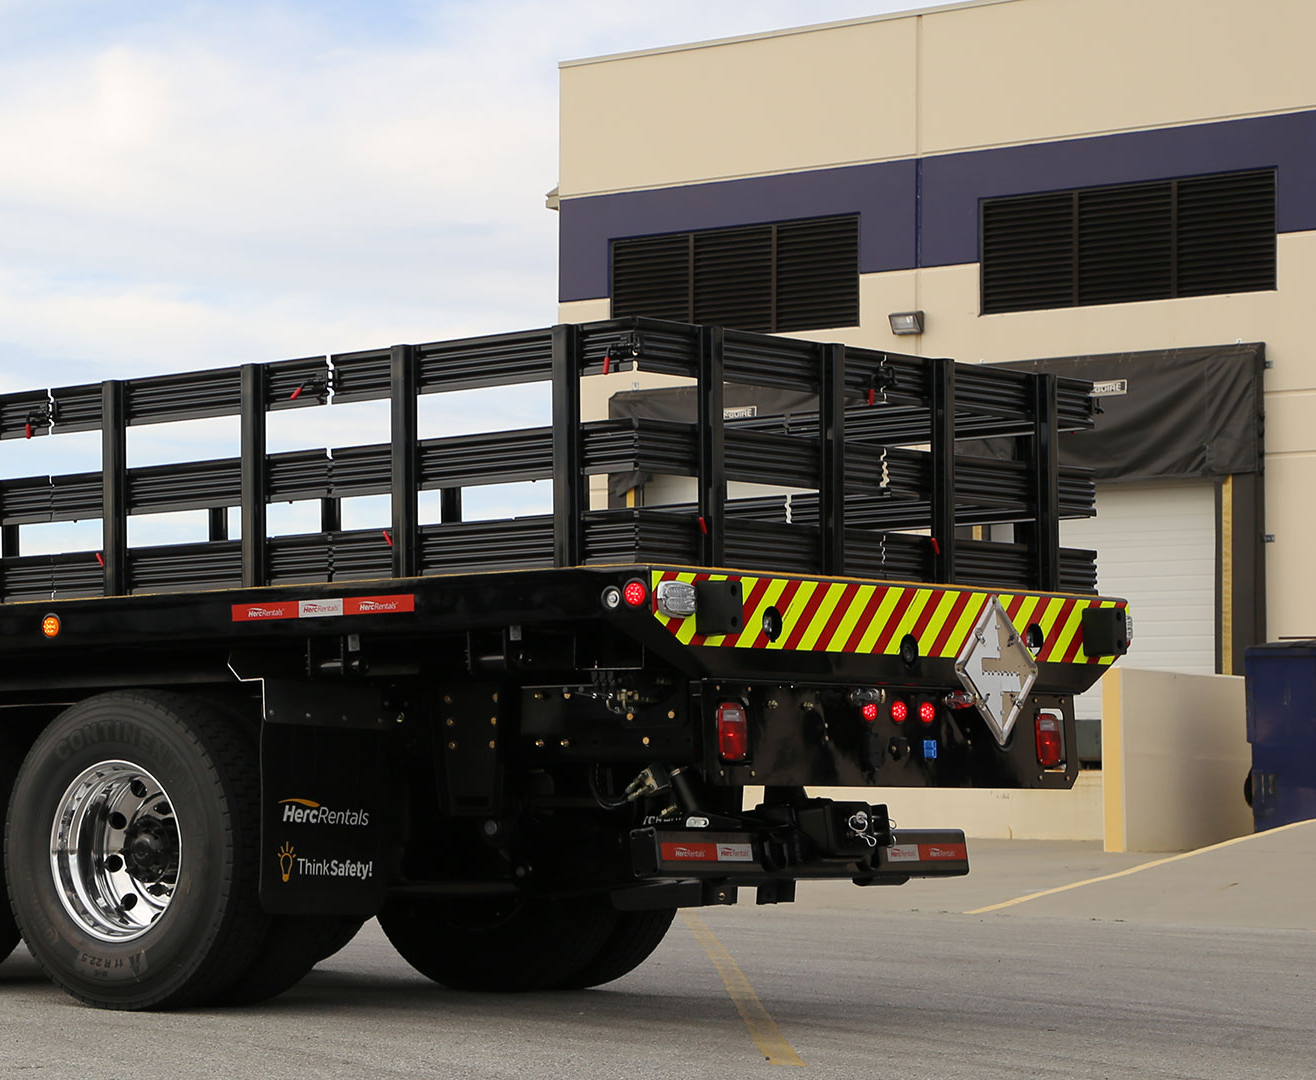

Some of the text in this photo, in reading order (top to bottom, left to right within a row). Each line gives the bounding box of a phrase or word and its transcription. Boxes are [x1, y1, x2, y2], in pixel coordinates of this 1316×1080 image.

[248, 608, 284, 617] HercRentals
[359, 601, 398, 611] HercRentals
[282, 804, 370, 826] HercRentals
[297, 858, 373, 880] ThinkSafety!
